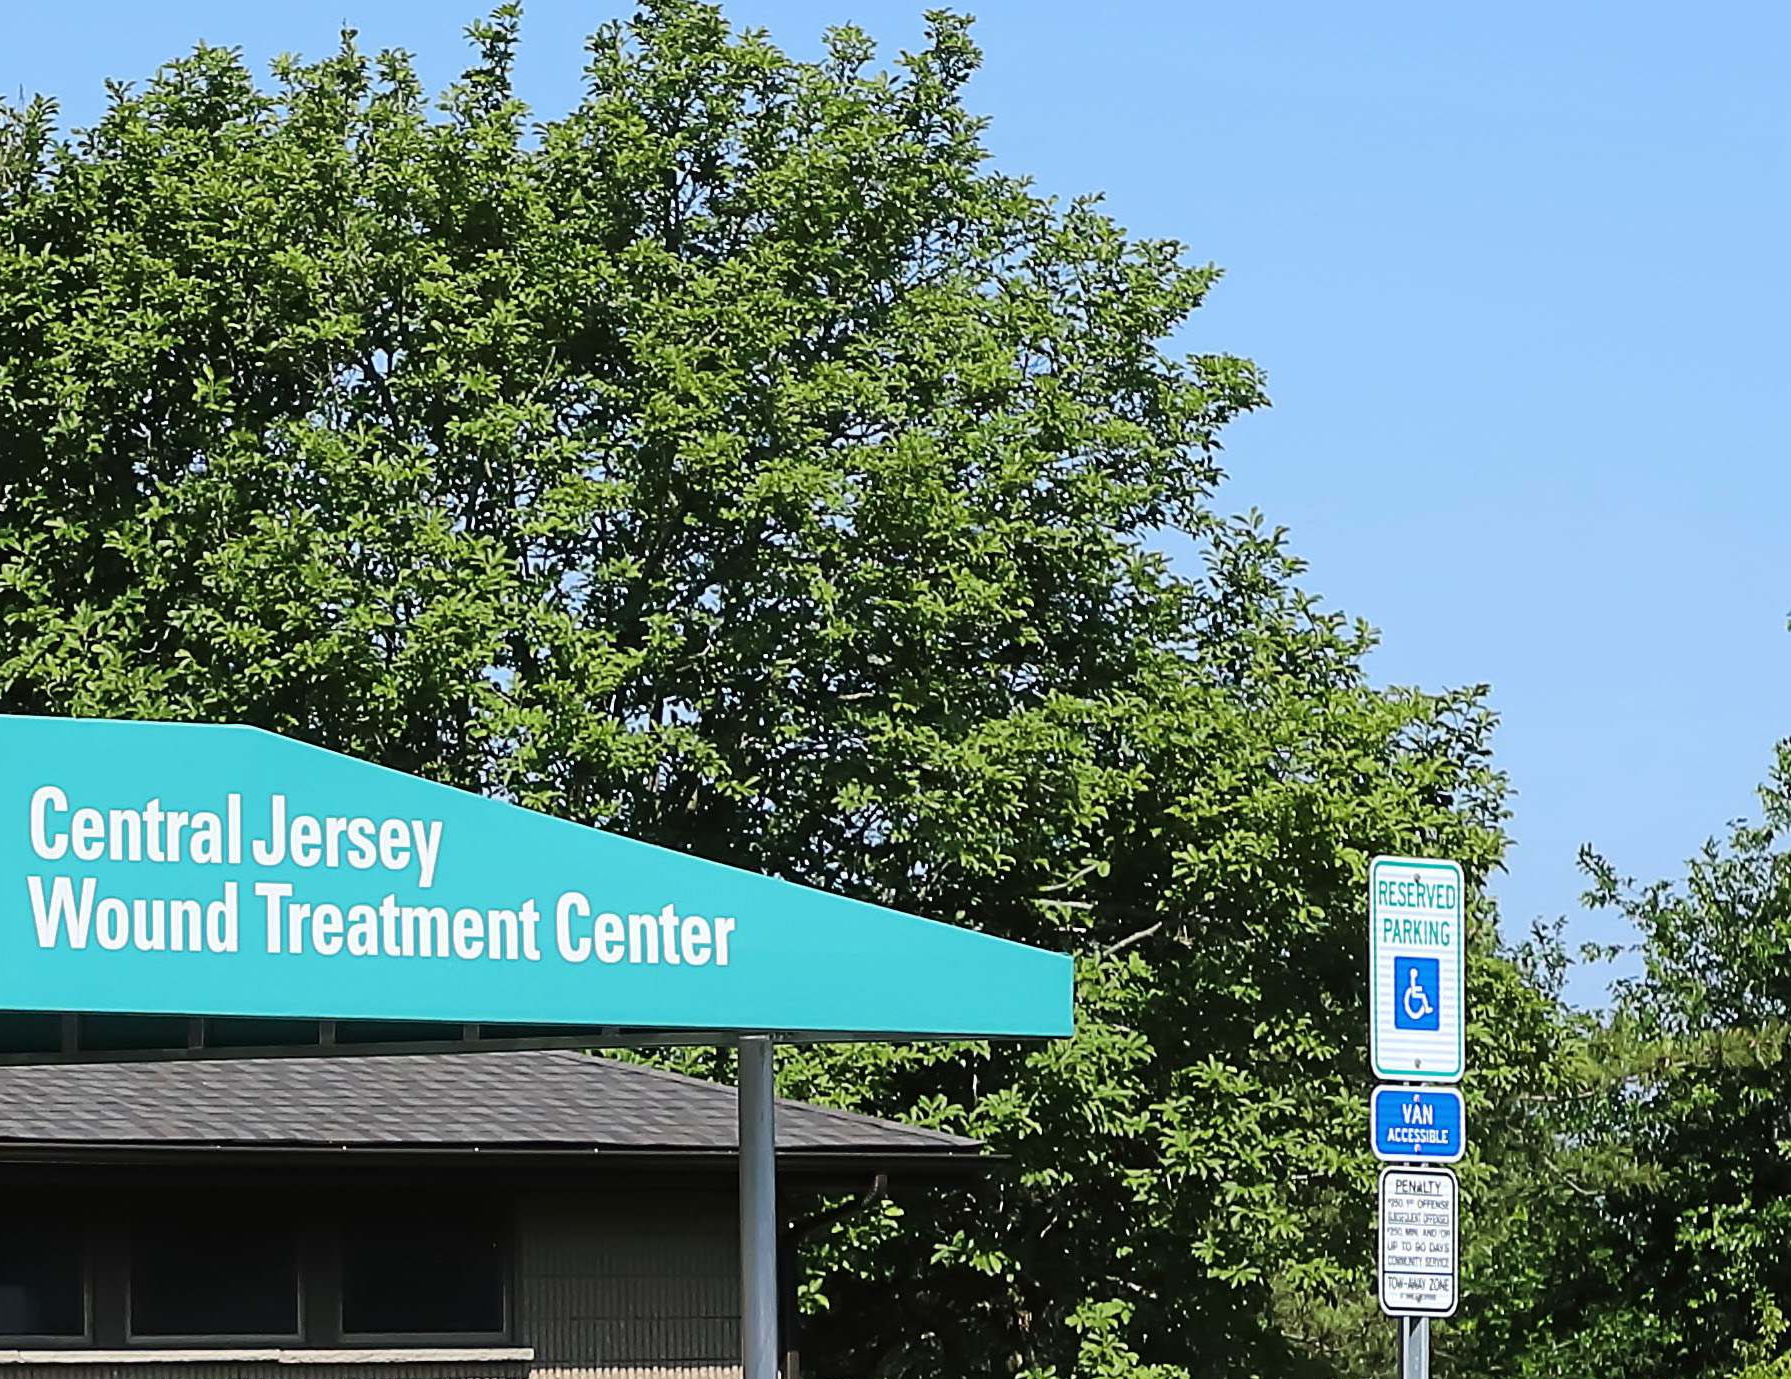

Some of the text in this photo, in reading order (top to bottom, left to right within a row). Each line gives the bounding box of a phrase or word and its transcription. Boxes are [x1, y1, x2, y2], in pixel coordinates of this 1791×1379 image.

[29, 785, 443, 888] Central Jersey
[1379, 881, 1456, 910] RESERVED
[26, 874, 736, 967] Wound Treatment Center
[1383, 918, 1450, 947] PARKING
[1402, 1103, 1433, 1125] VAN
[1387, 1128, 1449, 1144] ACCESSIBLE
[1395, 1178, 1442, 1195] PENALTY
